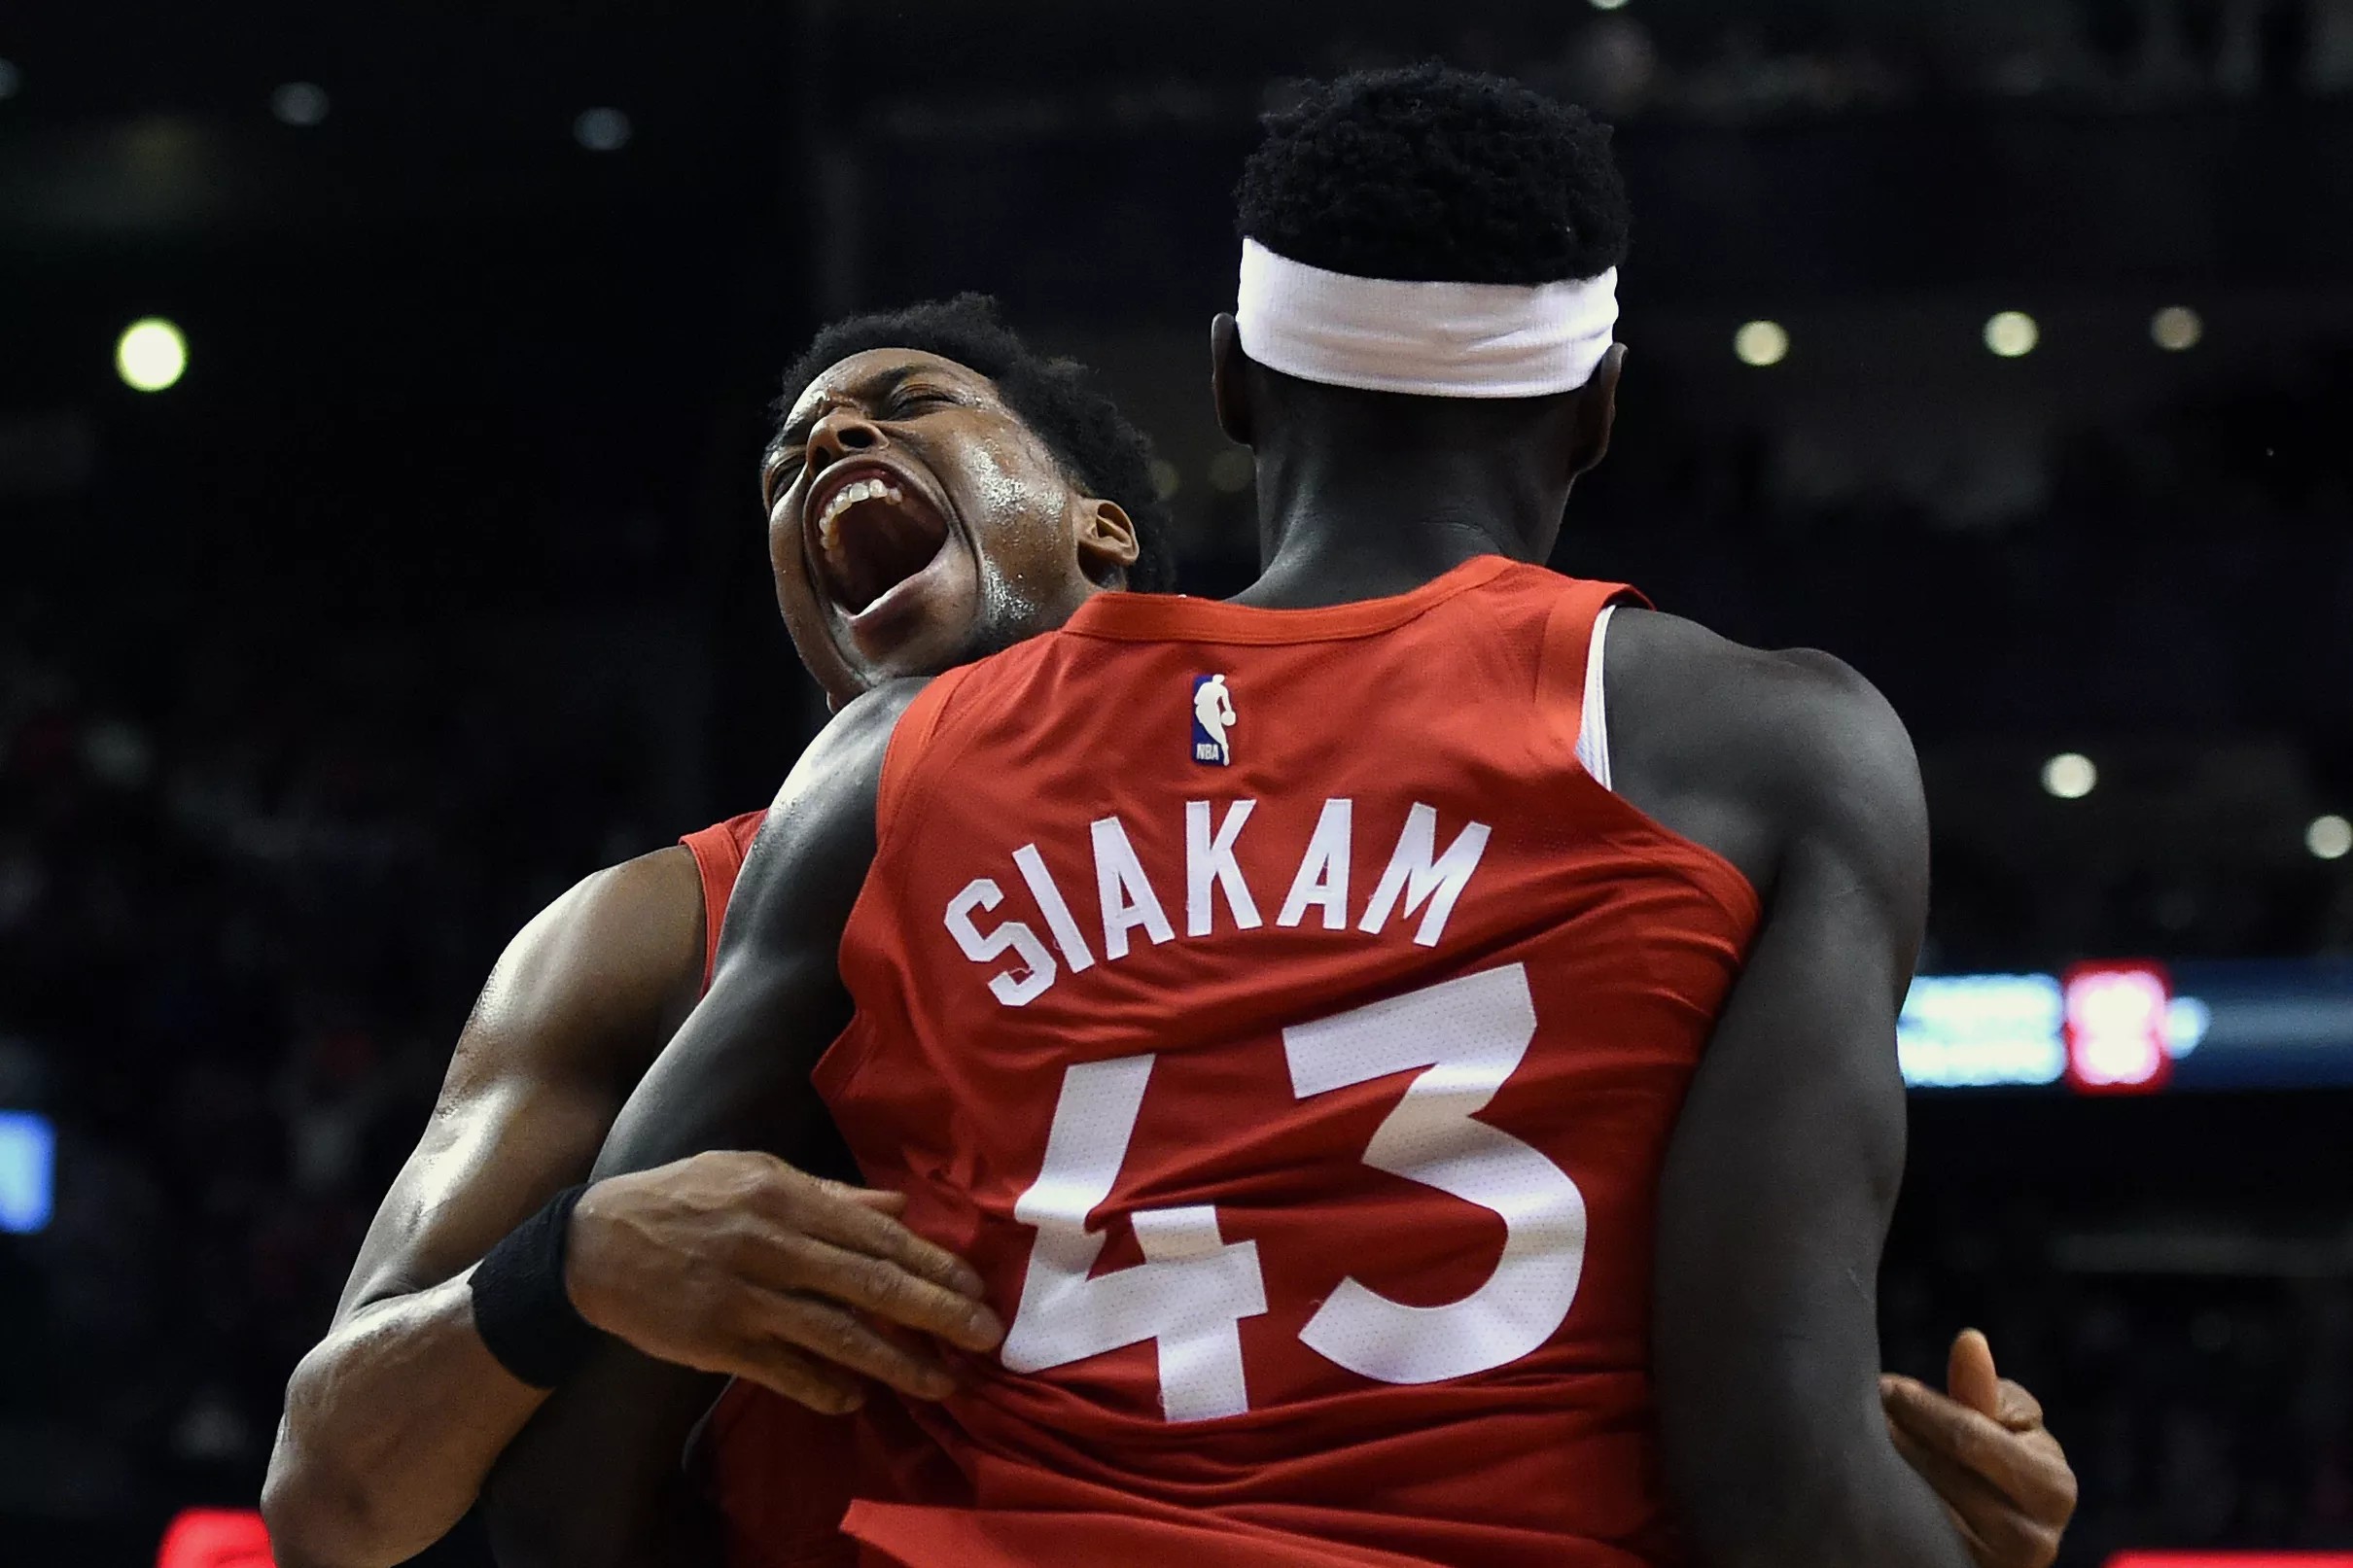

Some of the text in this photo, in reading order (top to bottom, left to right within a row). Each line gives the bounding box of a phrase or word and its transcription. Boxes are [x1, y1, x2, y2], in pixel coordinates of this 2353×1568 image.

[1196, 743, 1219, 760] NBA
[944, 797, 1493, 1007] SIAKAM
[1001, 961, 1589, 1423] 43
